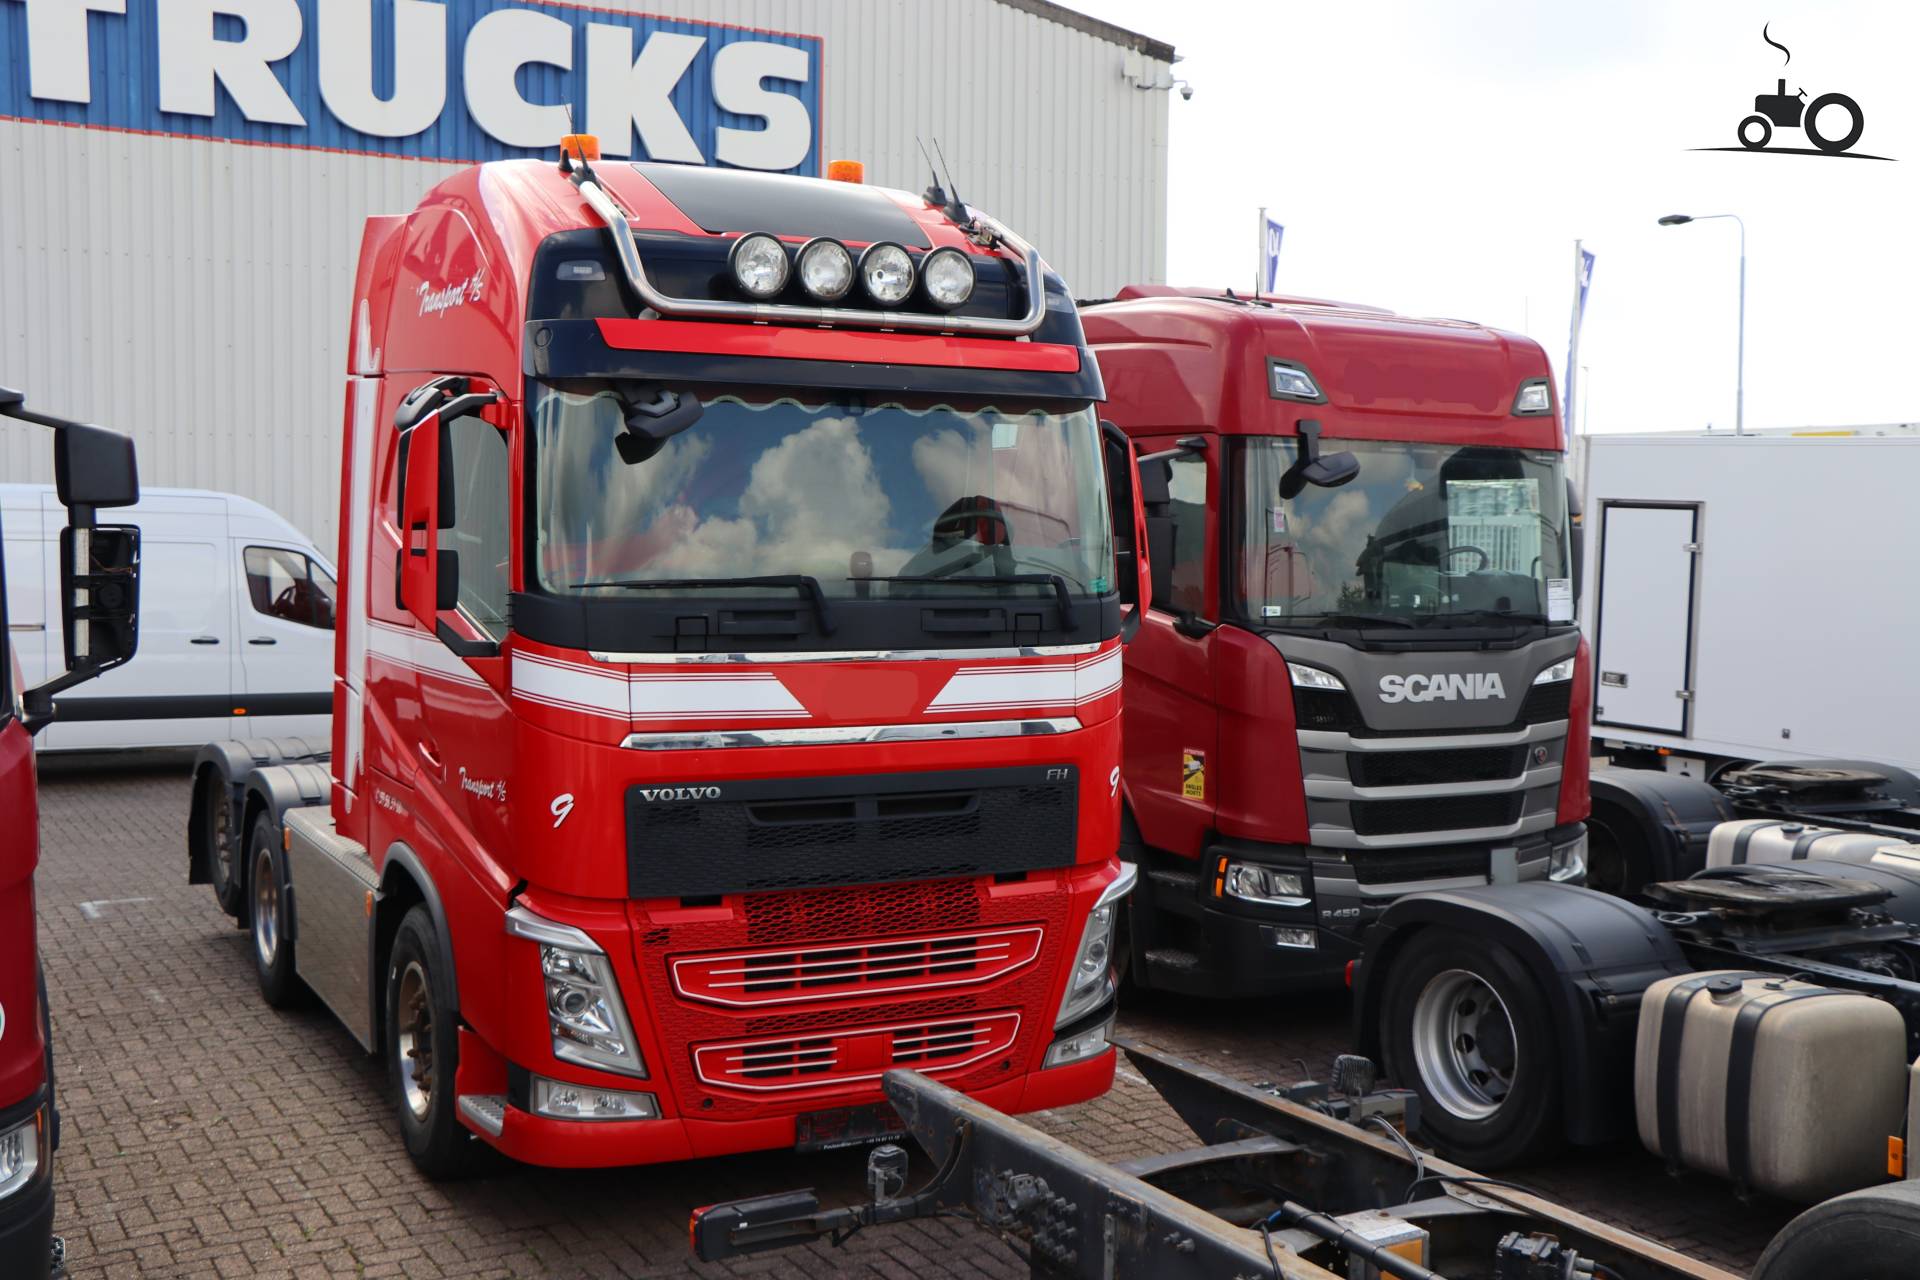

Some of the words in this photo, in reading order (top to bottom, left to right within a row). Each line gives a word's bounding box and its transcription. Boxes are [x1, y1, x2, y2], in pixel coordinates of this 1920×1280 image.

[0, 0, 812, 171] TRUCKS
[418, 278, 469, 319] Transport
[1378, 672, 1507, 704] SCANIA
[459, 766, 495, 800] Transport
[1046, 768, 1068, 780] FH
[1109, 765, 1120, 797] 9
[640, 786, 721, 801] VOLVO
[550, 793, 575, 829] 9
